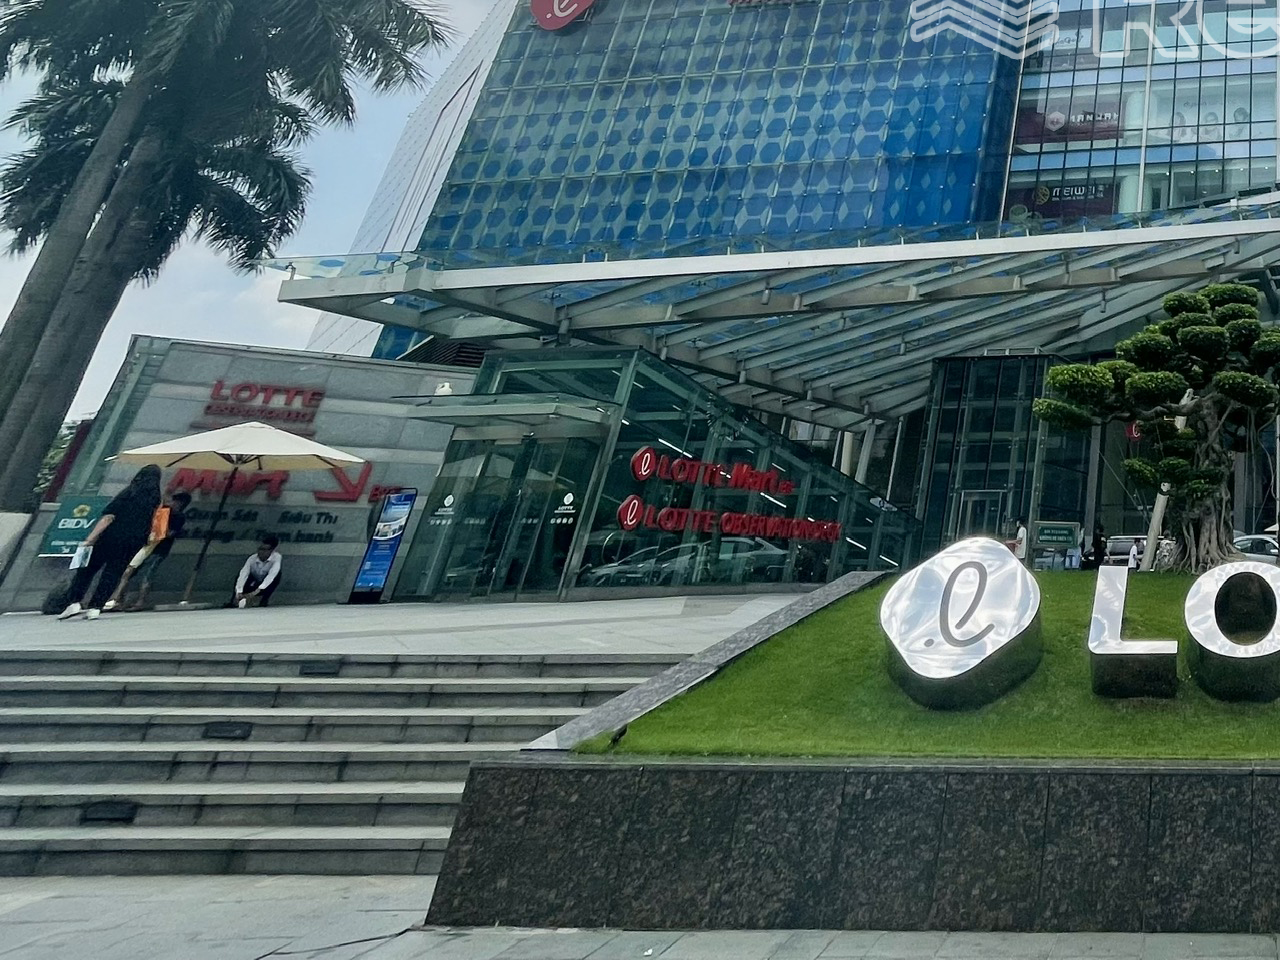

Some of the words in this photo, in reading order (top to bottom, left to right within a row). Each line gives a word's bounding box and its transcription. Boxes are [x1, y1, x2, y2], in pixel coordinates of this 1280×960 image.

[210, 379, 326, 408] LOTTE
[656, 454, 723, 488] LOTTE
[729, 462, 780, 495] Mart
[58, 517, 97, 530] BIDV
[643, 504, 718, 532] LOTTE
